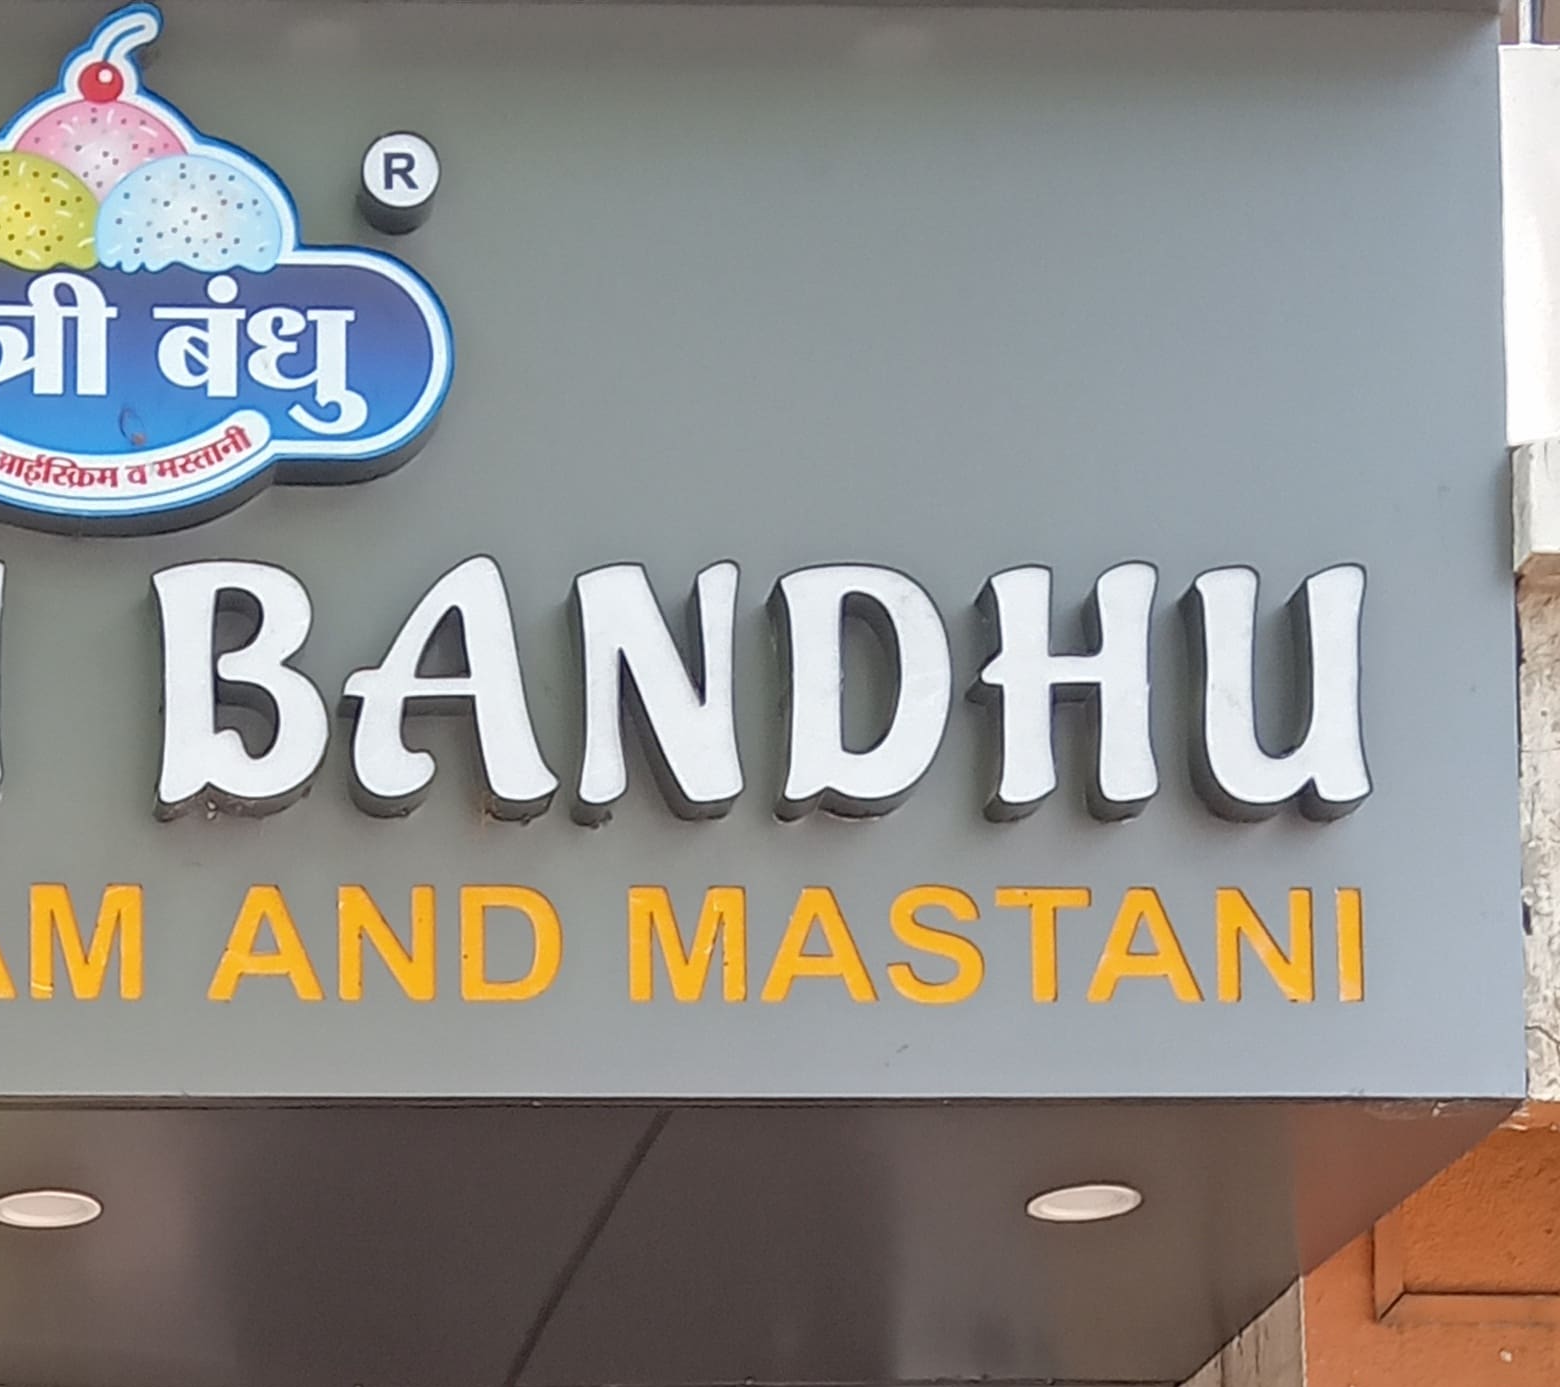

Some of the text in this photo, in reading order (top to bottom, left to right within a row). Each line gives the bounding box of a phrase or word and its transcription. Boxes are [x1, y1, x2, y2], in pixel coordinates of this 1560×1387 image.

[153, 273, 368, 435] बंधु
[124, 464, 147, 485] व
[155, 425, 252, 478] मस्तानी
[152, 555, 1371, 804] BANDHU
[209, 886, 561, 1001] AND
[628, 887, 1361, 1004] MASTANI
